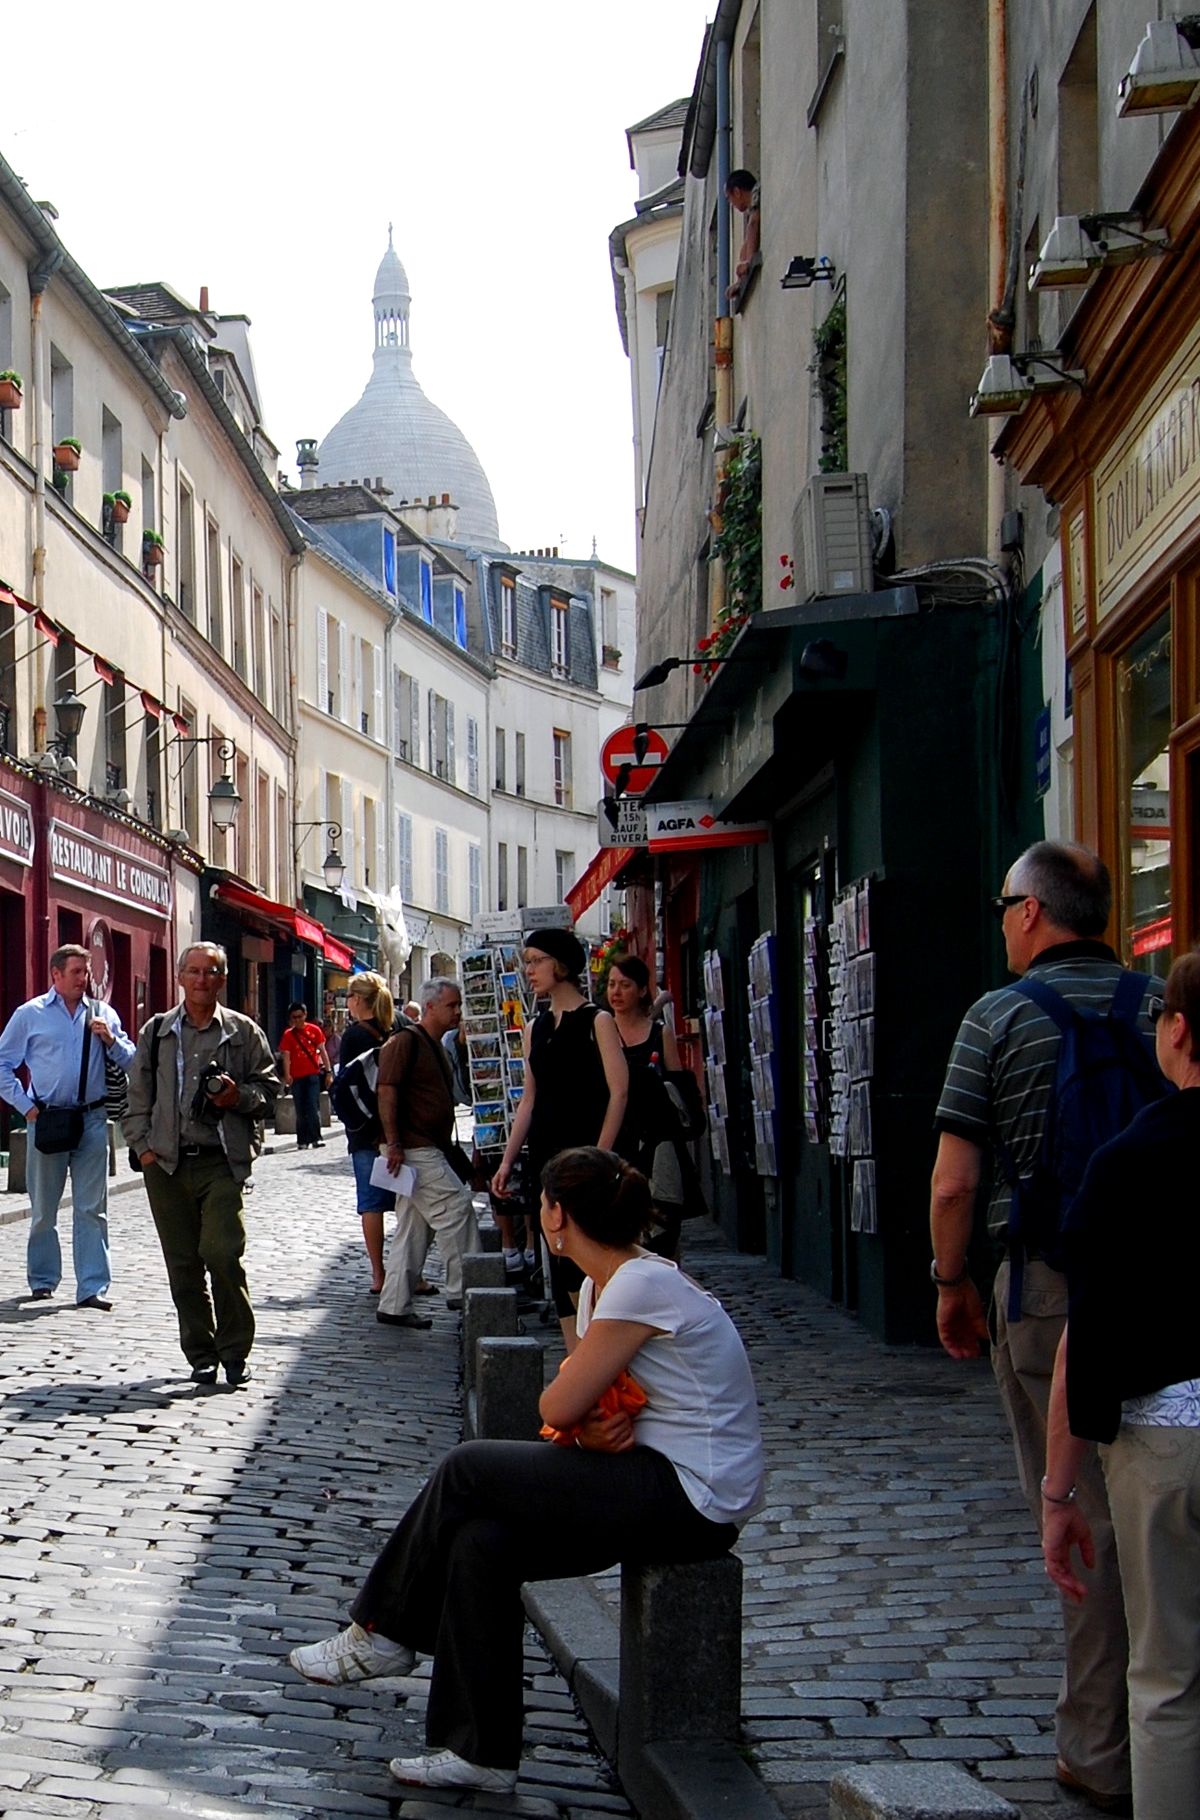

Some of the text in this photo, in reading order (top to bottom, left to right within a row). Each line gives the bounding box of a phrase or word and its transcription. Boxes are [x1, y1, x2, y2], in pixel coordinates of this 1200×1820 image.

[658, 818, 696, 832] AGFA
[52, 834, 169, 907] RESTAURANT LE CONSULAT
